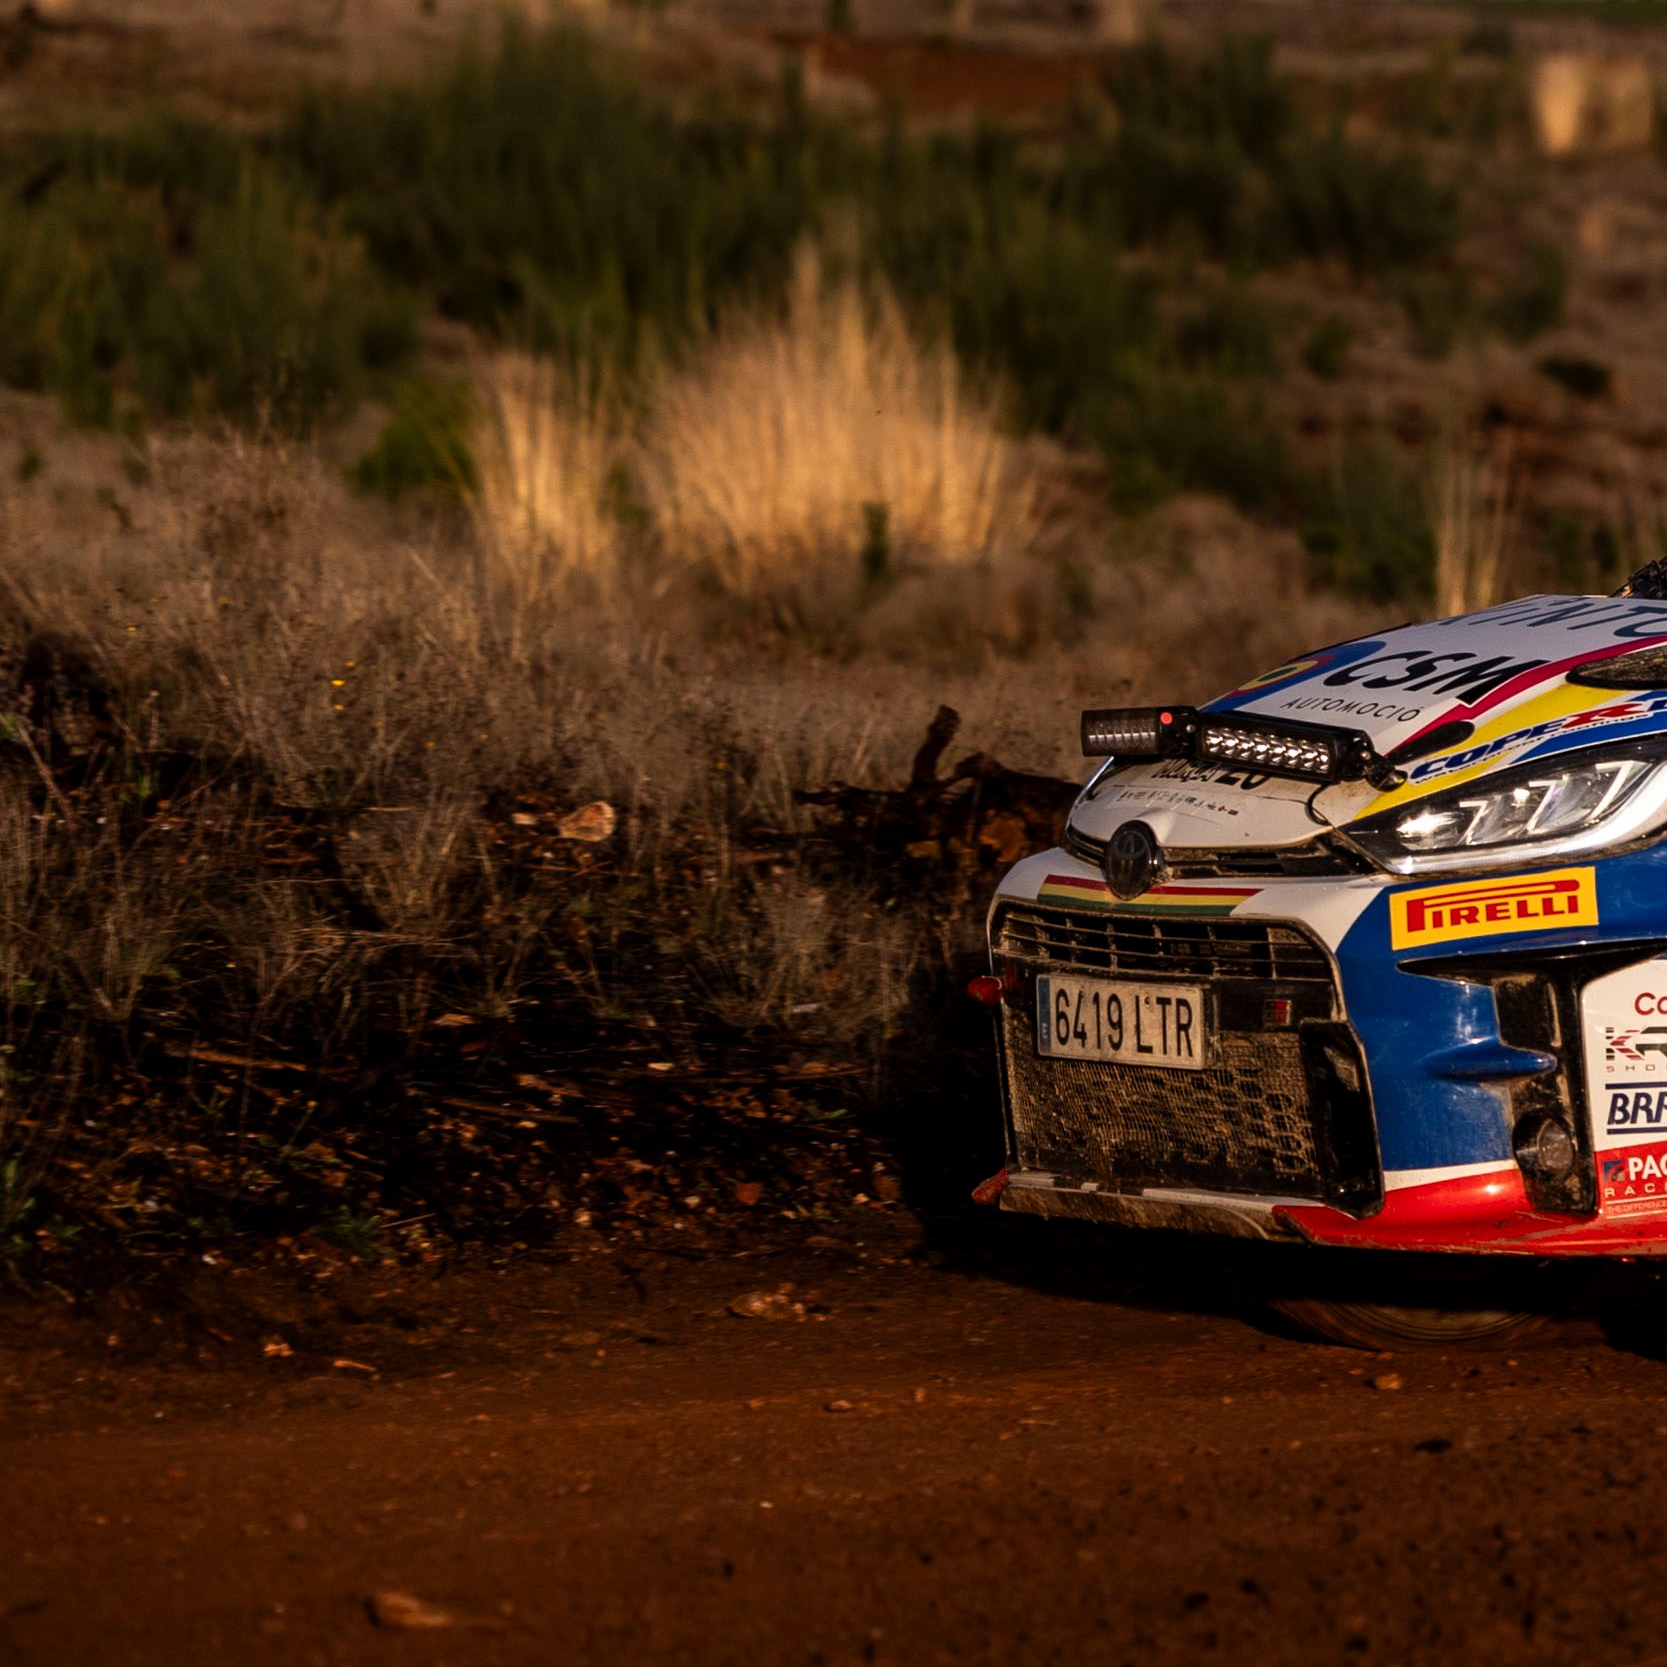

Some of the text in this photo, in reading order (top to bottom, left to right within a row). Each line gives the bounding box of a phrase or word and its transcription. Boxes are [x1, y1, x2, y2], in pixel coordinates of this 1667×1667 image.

[1323, 650, 1551, 705] CSM
[1280, 697, 1421, 722] AUTOMOCIÓ
[1405, 879, 1580, 933] PIRELLI
[1055, 987, 1193, 1058] 6419 LTR
